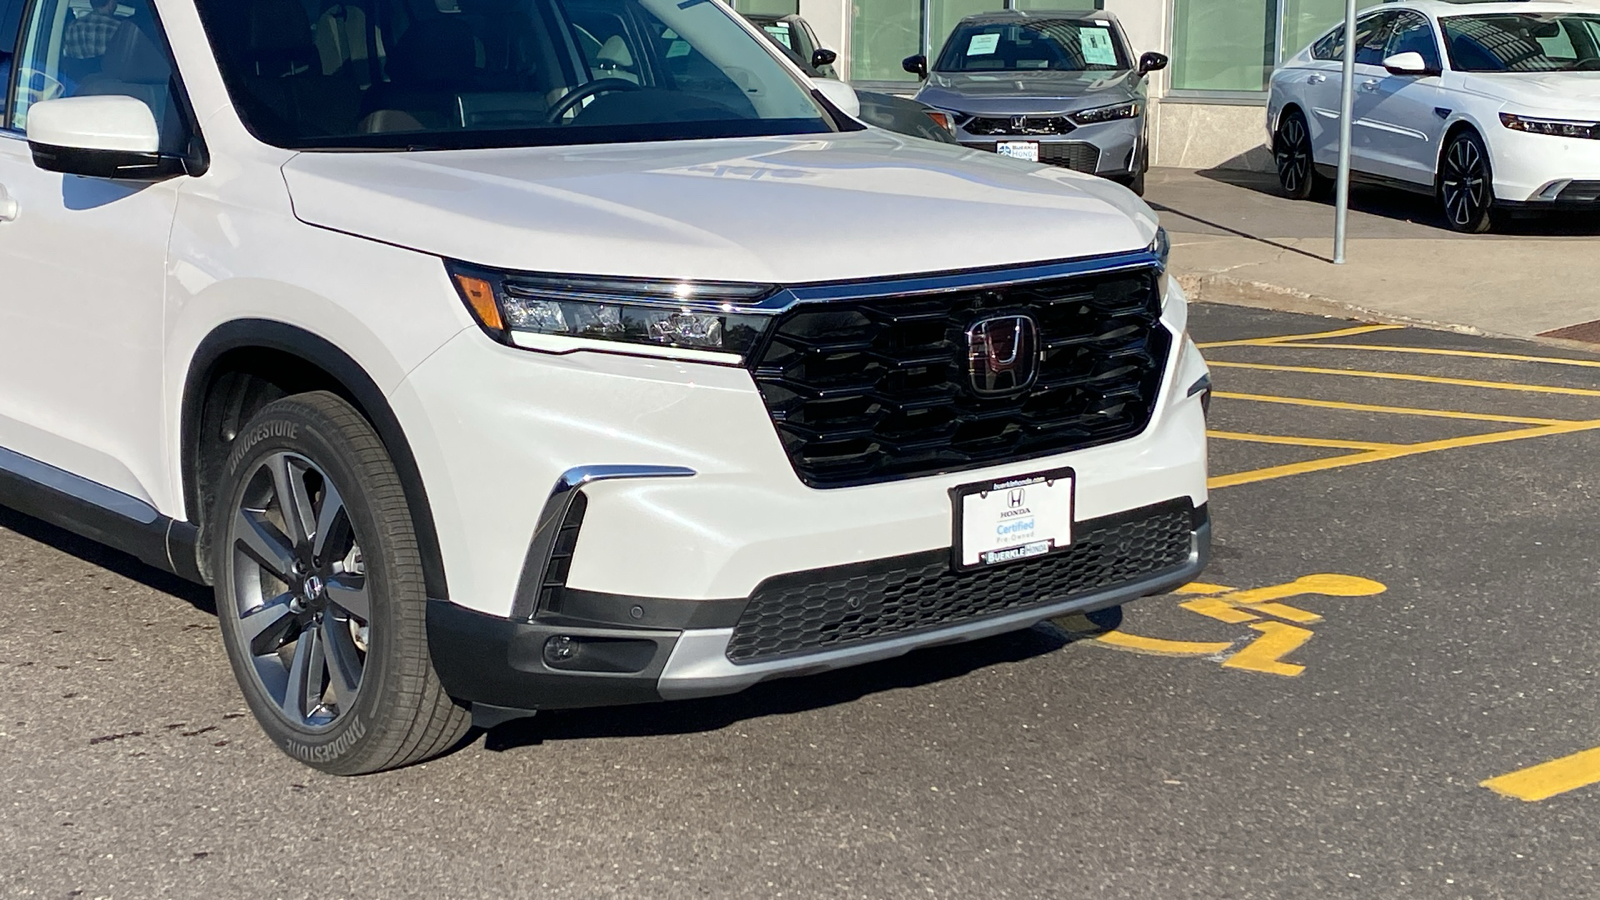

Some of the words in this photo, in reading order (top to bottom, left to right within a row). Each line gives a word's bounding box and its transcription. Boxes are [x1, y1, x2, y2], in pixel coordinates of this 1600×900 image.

[230, 420, 299, 477] BRIDGESTONE
[997, 519, 1034, 535] Certified
[1000, 508, 1031, 517] HONDA
[286, 714, 367, 763] BRIDGESTONE
